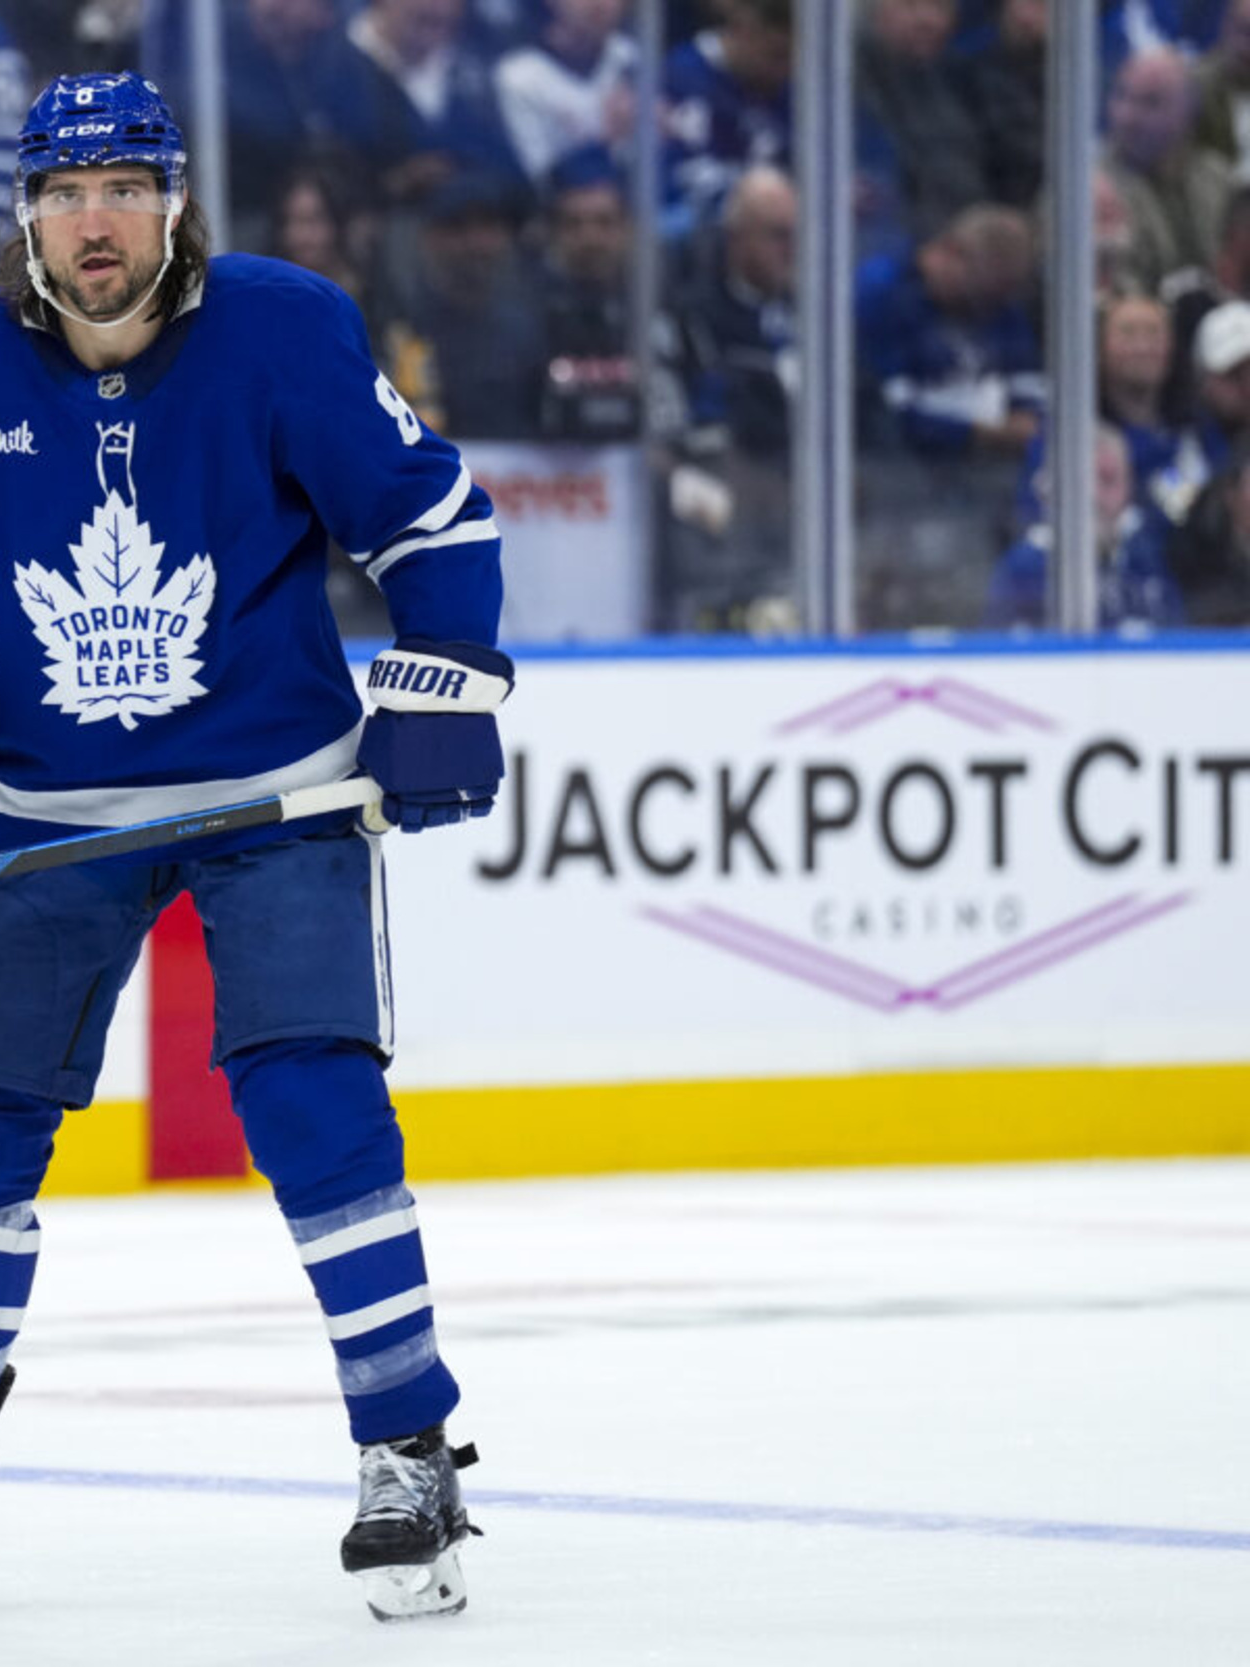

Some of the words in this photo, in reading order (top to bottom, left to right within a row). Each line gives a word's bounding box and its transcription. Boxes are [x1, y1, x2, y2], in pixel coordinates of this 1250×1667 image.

[57, 123, 117, 139] CCM
[373, 370, 423, 447] 8
[50, 604, 188, 641] TORONTO
[75, 637, 168, 661] MAPLE
[76, 662, 170, 686] LEAFS
[475, 748, 1029, 883] JACKPOT
[1061, 737, 1250, 868] CIT
[812, 896, 1027, 940] CASINO
